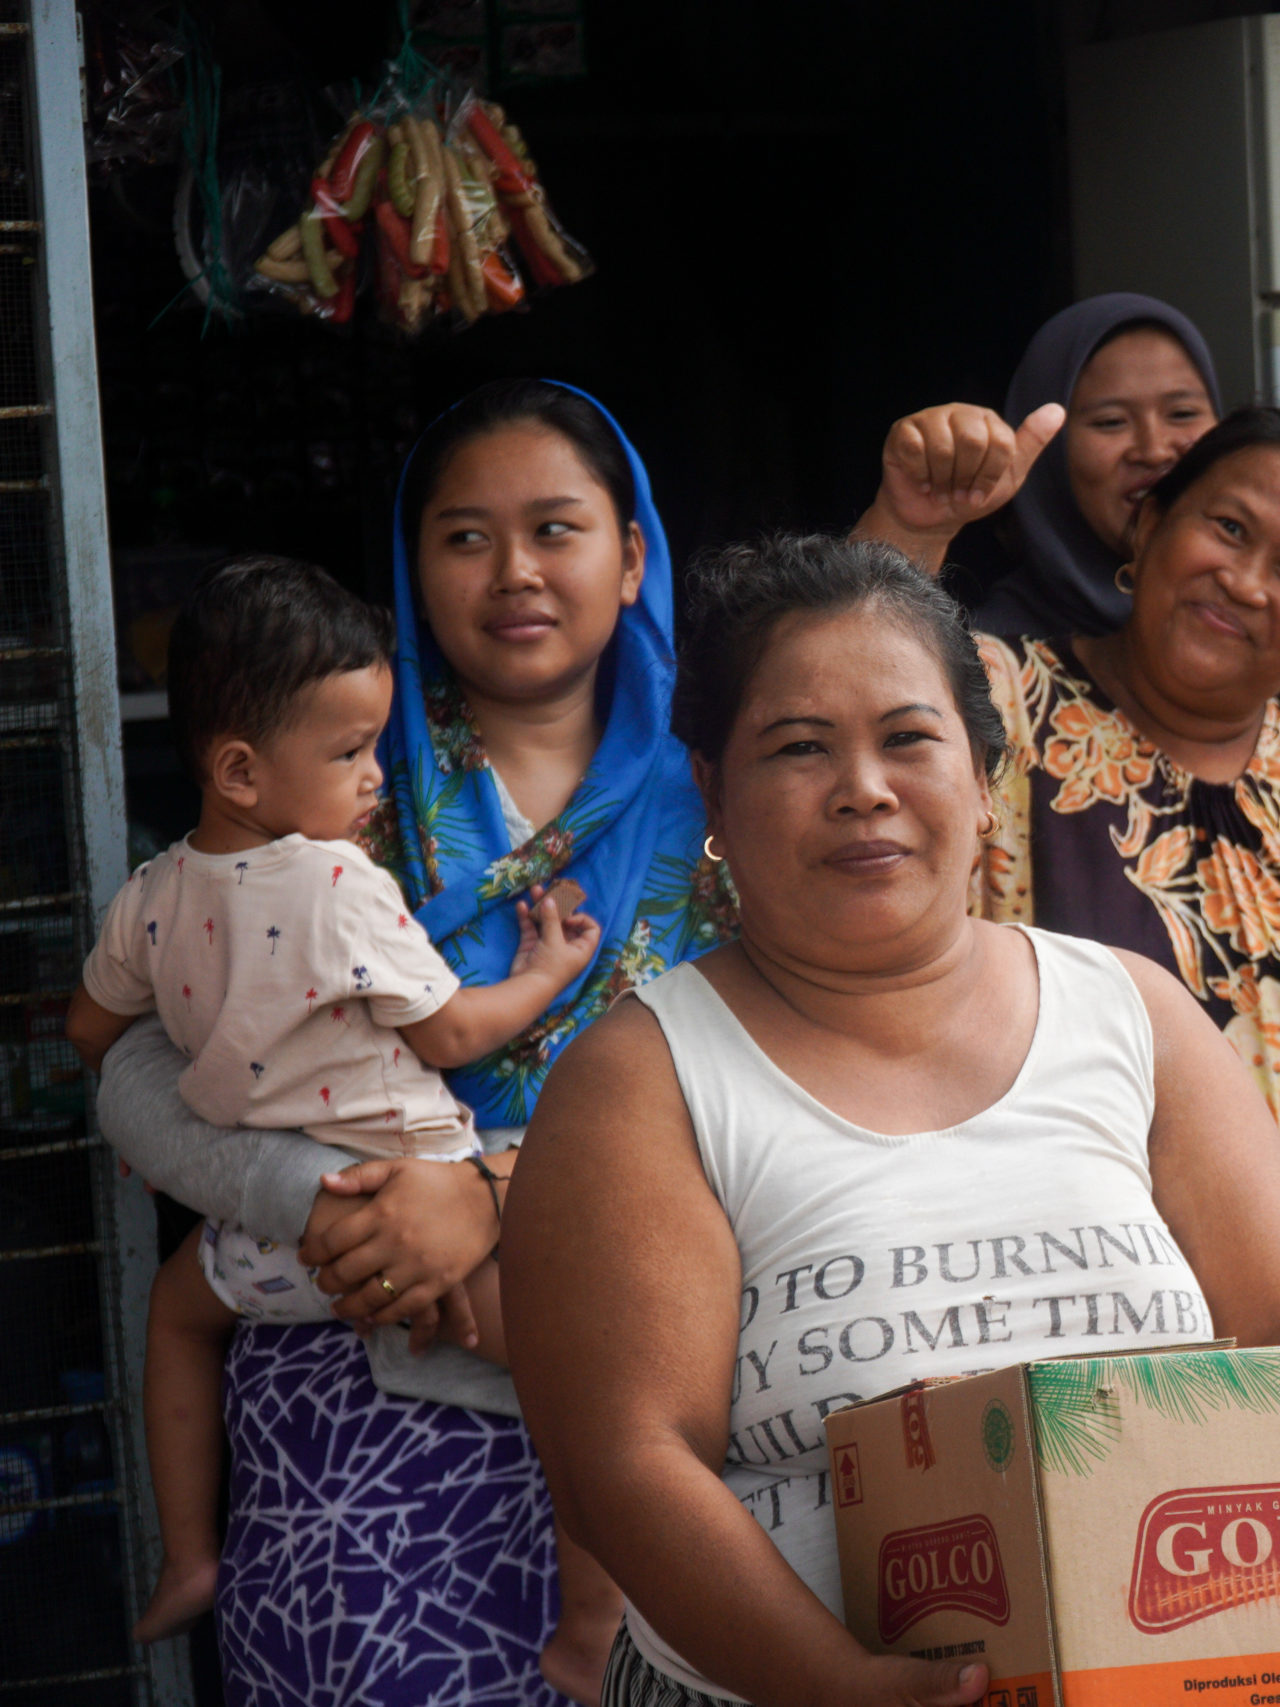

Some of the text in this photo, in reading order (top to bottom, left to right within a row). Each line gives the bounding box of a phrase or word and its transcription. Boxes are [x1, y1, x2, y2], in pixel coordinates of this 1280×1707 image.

[775, 1254, 865, 1314] TO
[798, 1299, 1013, 1376] SOME
[1207, 1502, 1264, 1515] MINYAK
[885, 1540, 994, 1601] GOLCO
[1183, 1673, 1258, 1692] Diproduksi
